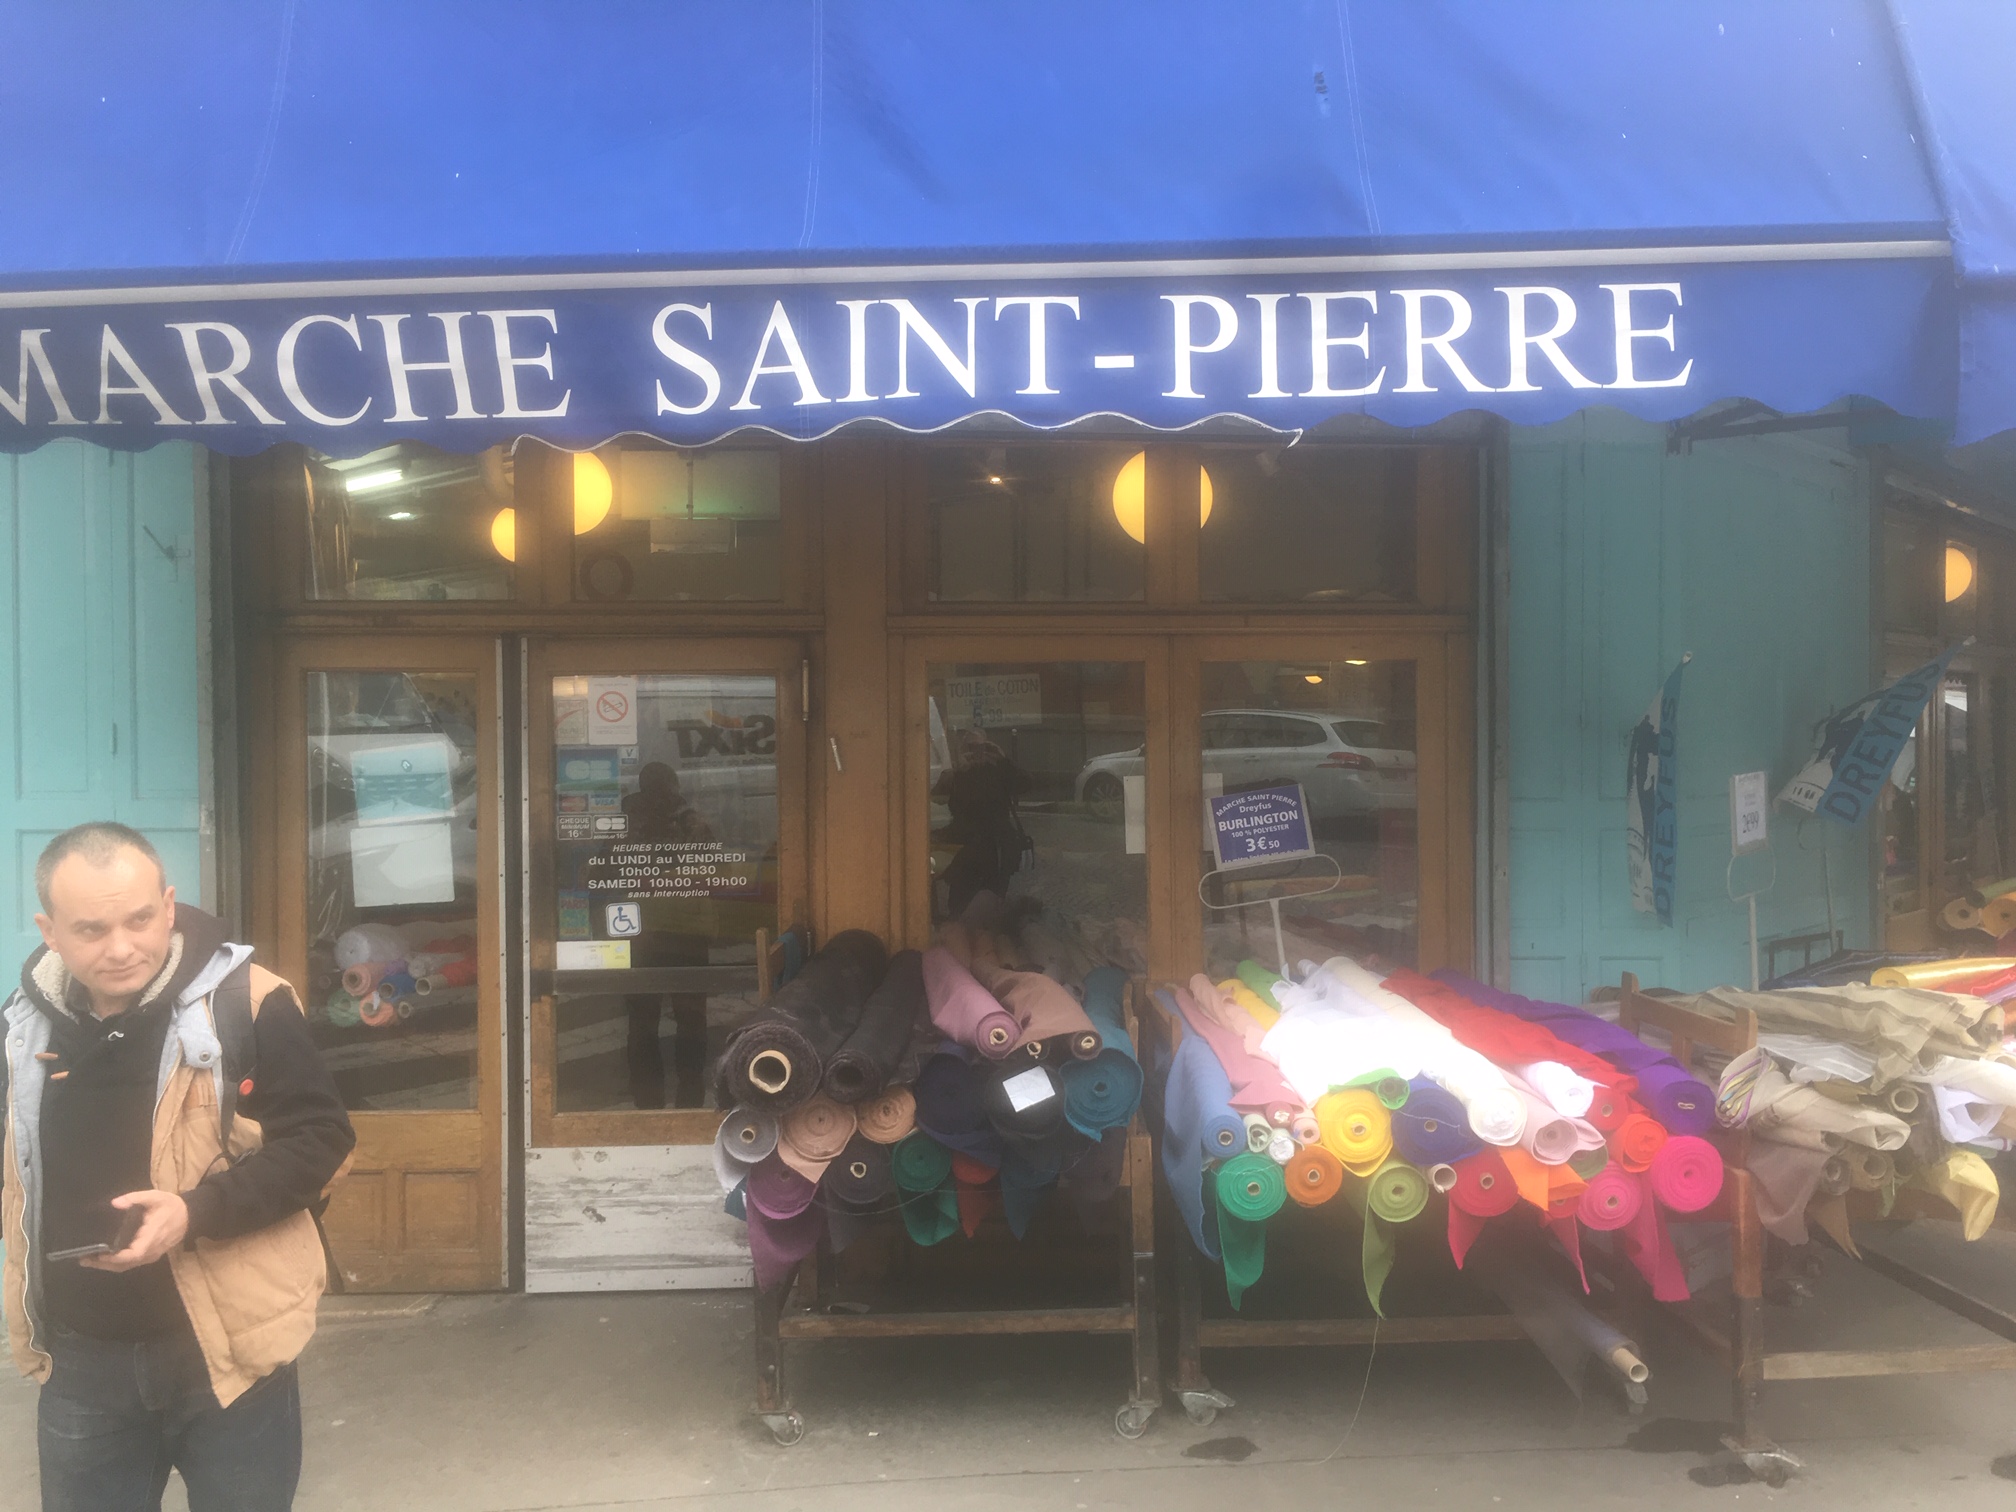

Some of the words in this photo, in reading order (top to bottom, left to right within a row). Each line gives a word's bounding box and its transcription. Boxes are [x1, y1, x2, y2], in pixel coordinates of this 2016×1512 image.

[0, 308, 571, 427] MARCHE
[948, 681, 983, 698] TOILE
[997, 678, 1039, 695] COTON
[1823, 662, 1942, 824] DREYFUS
[1215, 796, 1246, 817] MARCHE
[1246, 793, 1271, 802] SAINT
[1271, 794, 1298, 808] PIERRE
[1239, 802, 1272, 813] Dreyfus
[1655, 696, 1677, 921] DREYFUS
[1218, 809, 1299, 832] BURLINGTON
[1253, 823, 1290, 835] POLYESTER
[612, 843, 652, 852] HEURES
[654, 841, 723, 851] D'OUVERTURE
[1268, 840, 1280, 849] 50
[588, 855, 606, 866] du
[610, 854, 651, 865] LUNDI
[656, 855, 673, 864] au
[676, 852, 746, 864] VENDREDI
[618, 866, 660, 877] 10h00
[675, 864, 717, 876] 18h30
[588, 878, 641, 889] SAMEDI
[649, 877, 692, 888] 10h00
[705, 876, 748, 887] 19h00
[627, 890, 651, 899] sans
[653, 889, 710, 899] interruption
